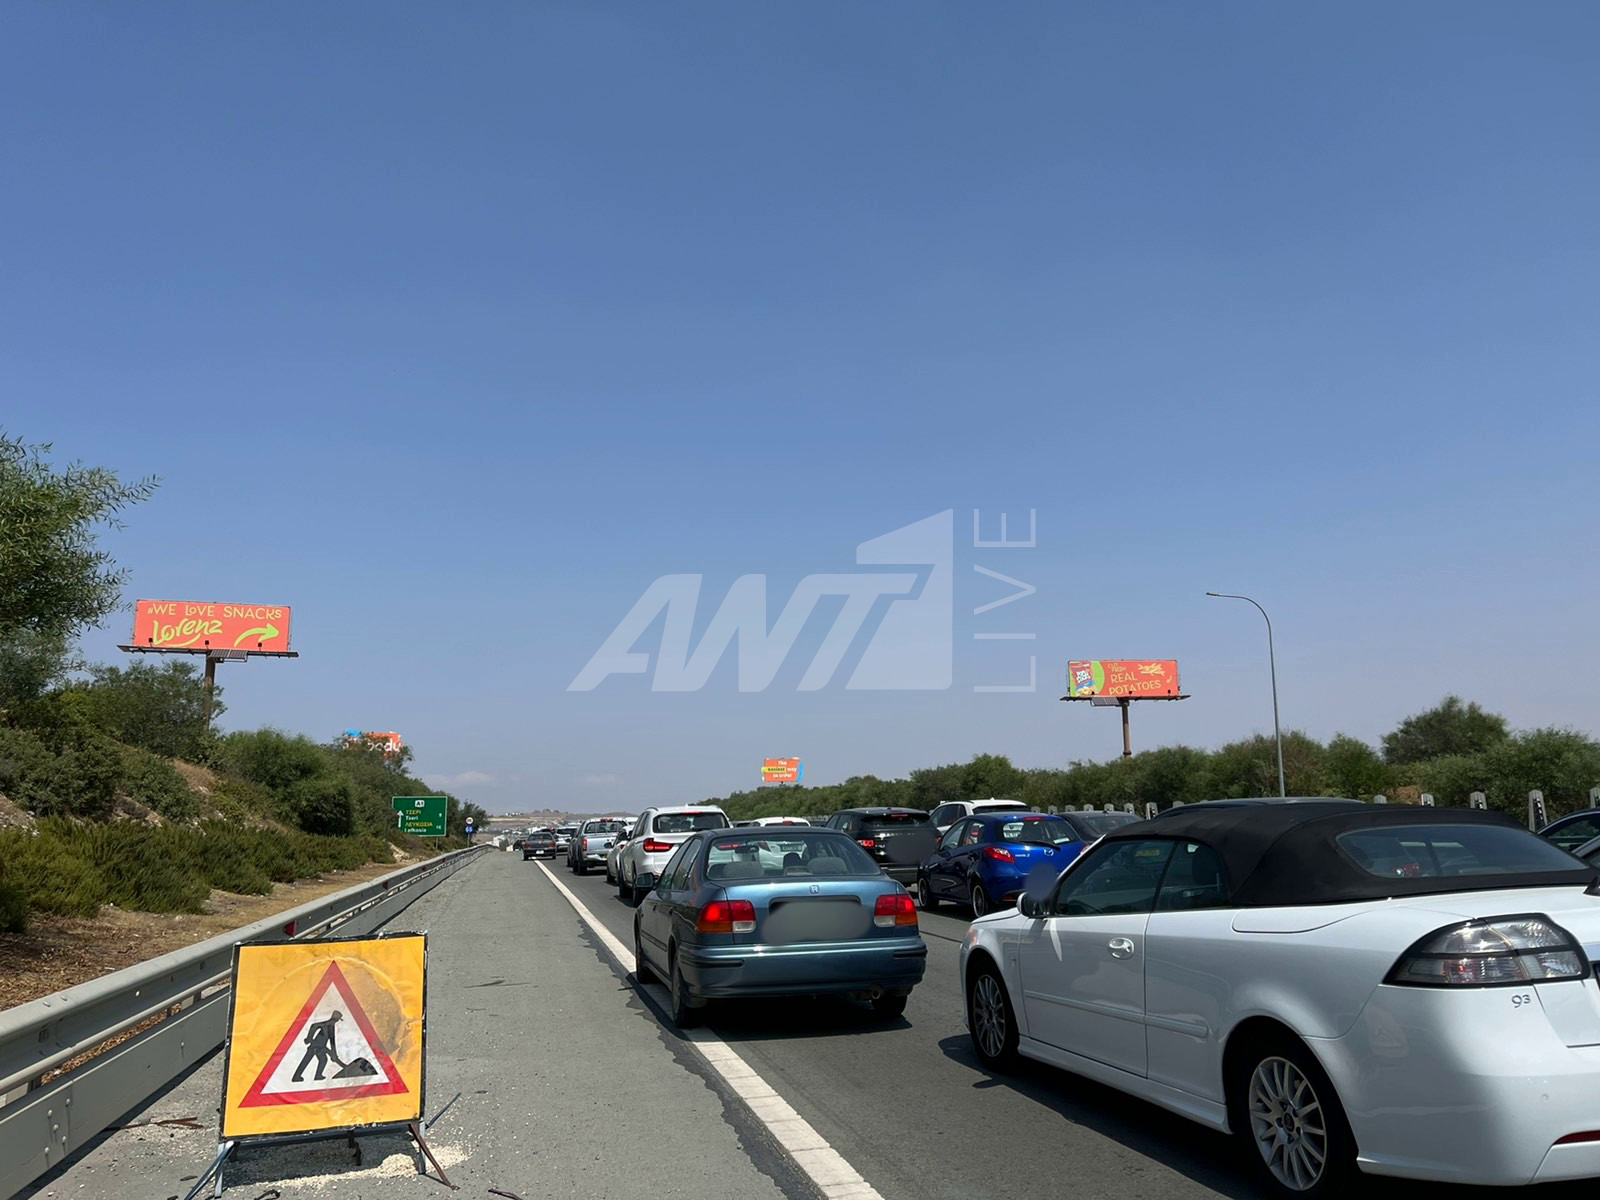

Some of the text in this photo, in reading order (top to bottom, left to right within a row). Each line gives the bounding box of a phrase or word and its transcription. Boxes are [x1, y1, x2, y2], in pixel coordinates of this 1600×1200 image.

[153, 618, 223, 646] Lorenz
[1110, 672, 1137, 684] REAL
[1109, 680, 1161, 696] POTATOES
